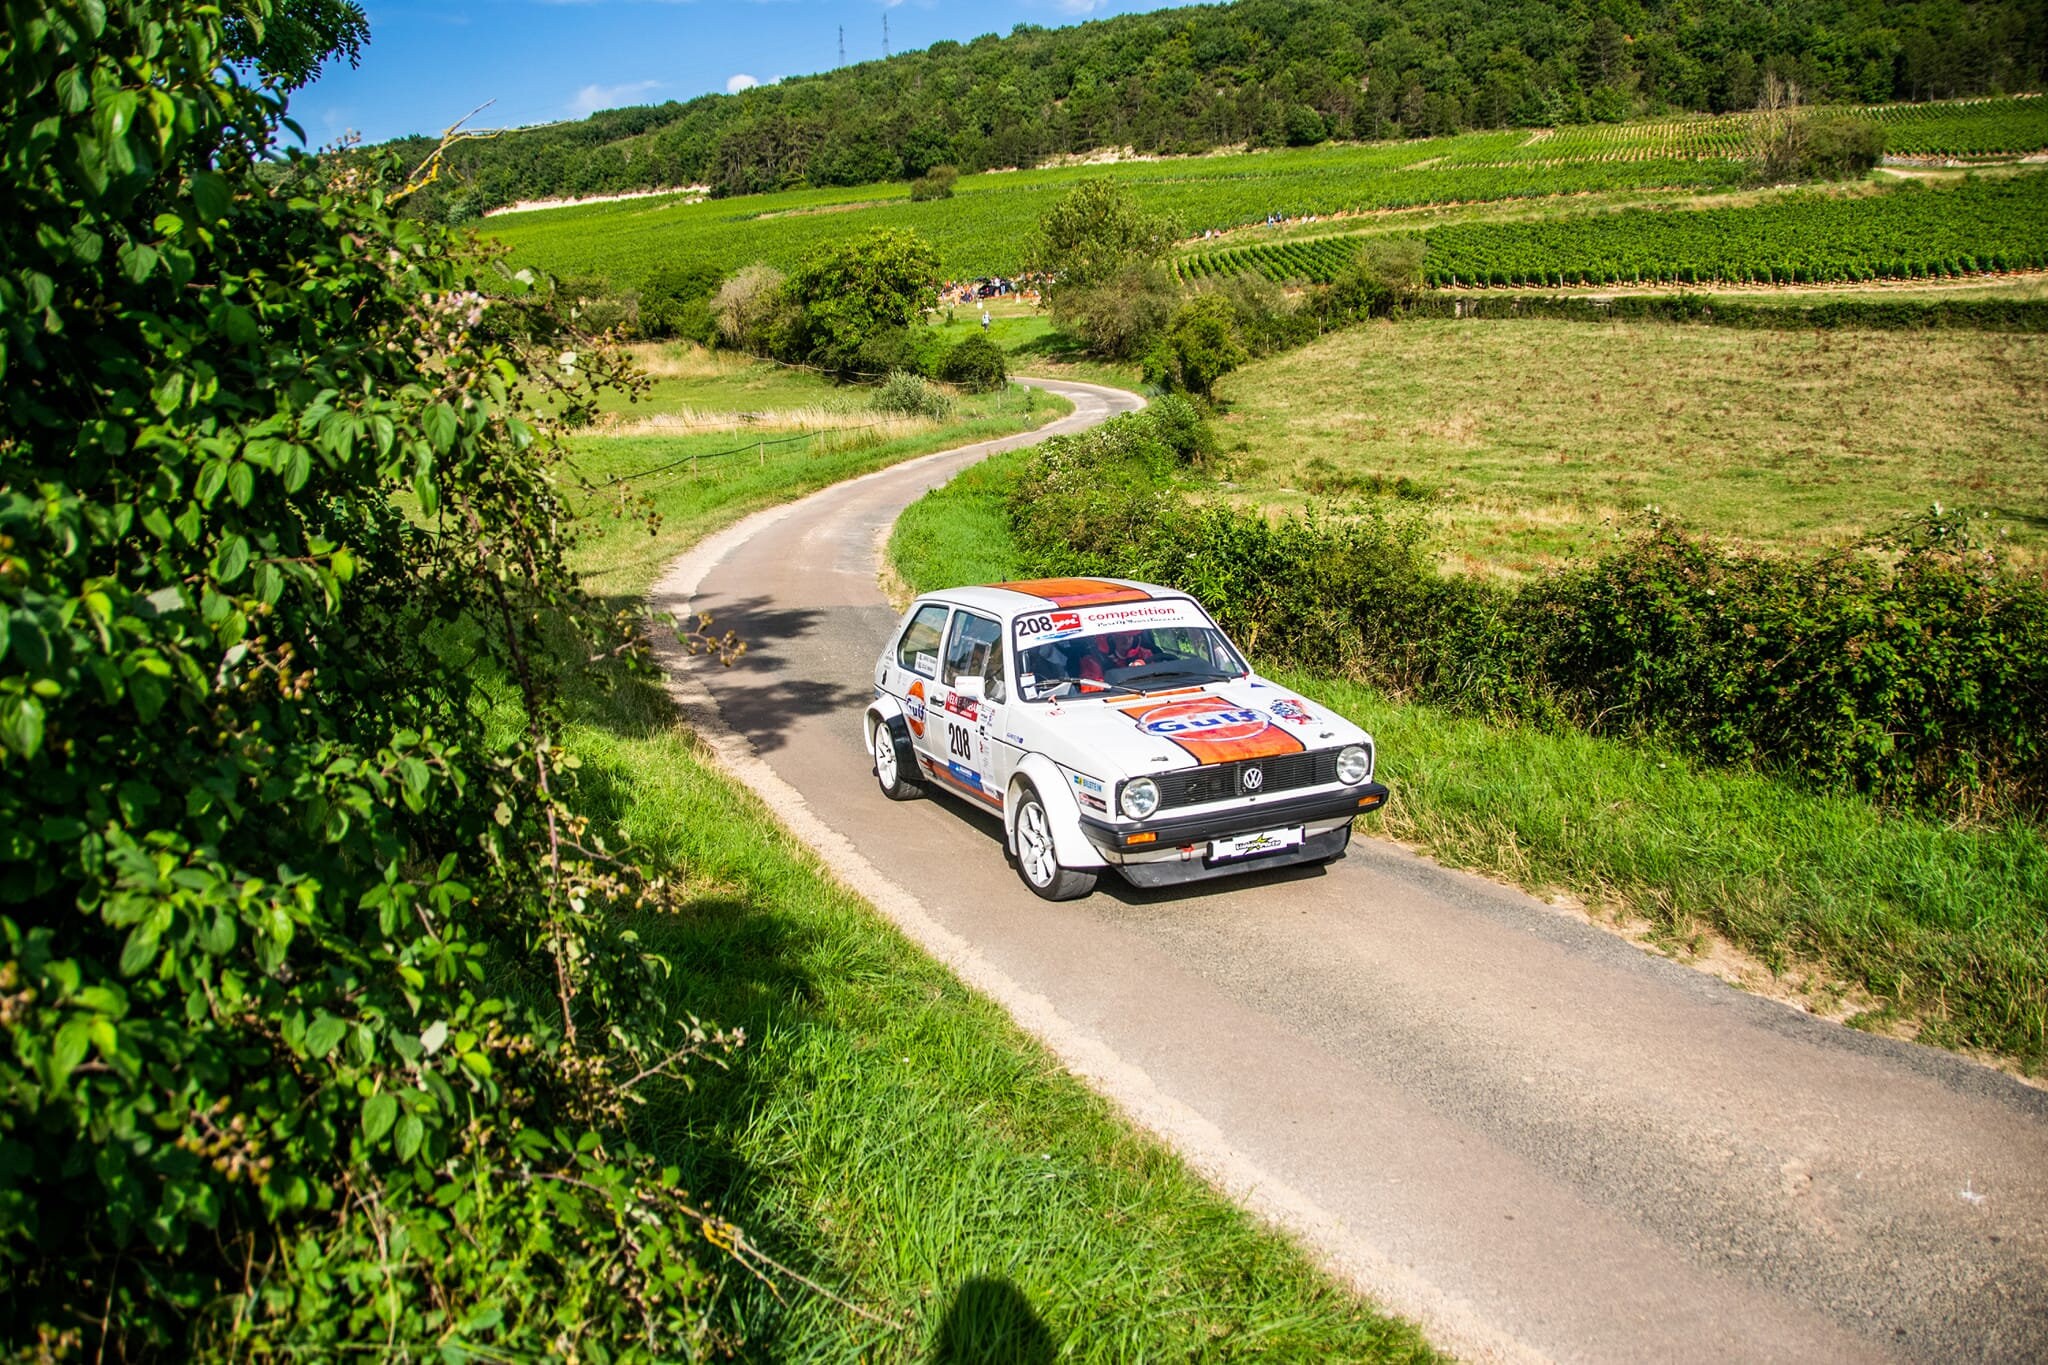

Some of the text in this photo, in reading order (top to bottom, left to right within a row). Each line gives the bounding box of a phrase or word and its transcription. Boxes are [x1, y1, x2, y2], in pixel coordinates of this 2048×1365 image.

[1088, 607, 1176, 621] competition
[1016, 616, 1052, 637] 208
[907, 697, 925, 721] Gulf
[1147, 710, 1258, 732] Gulf
[948, 722, 971, 760] 208
[1244, 768, 1262, 789] VW
